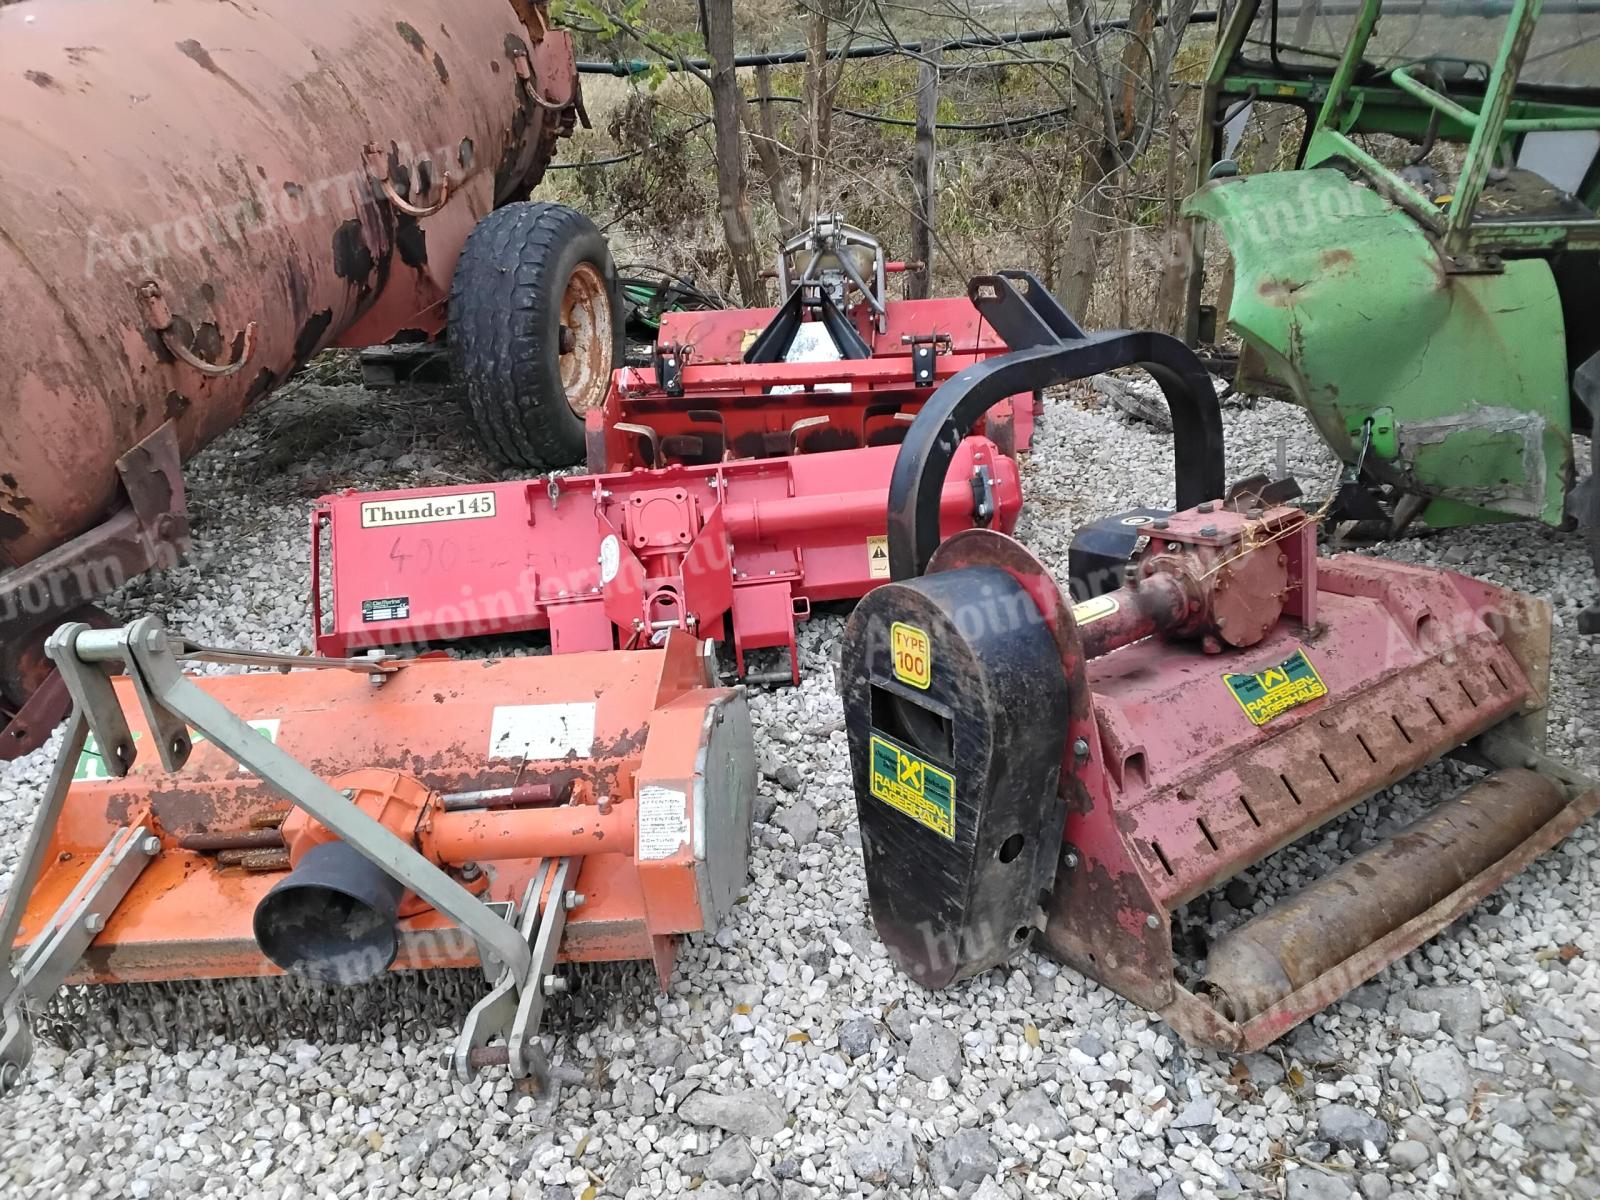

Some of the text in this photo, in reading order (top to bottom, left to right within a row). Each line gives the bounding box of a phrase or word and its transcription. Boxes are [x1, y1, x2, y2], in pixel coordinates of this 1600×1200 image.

[364, 496, 493, 523] Thunder145
[896, 632, 925, 654] TYPE
[896, 651, 924, 676] 100
